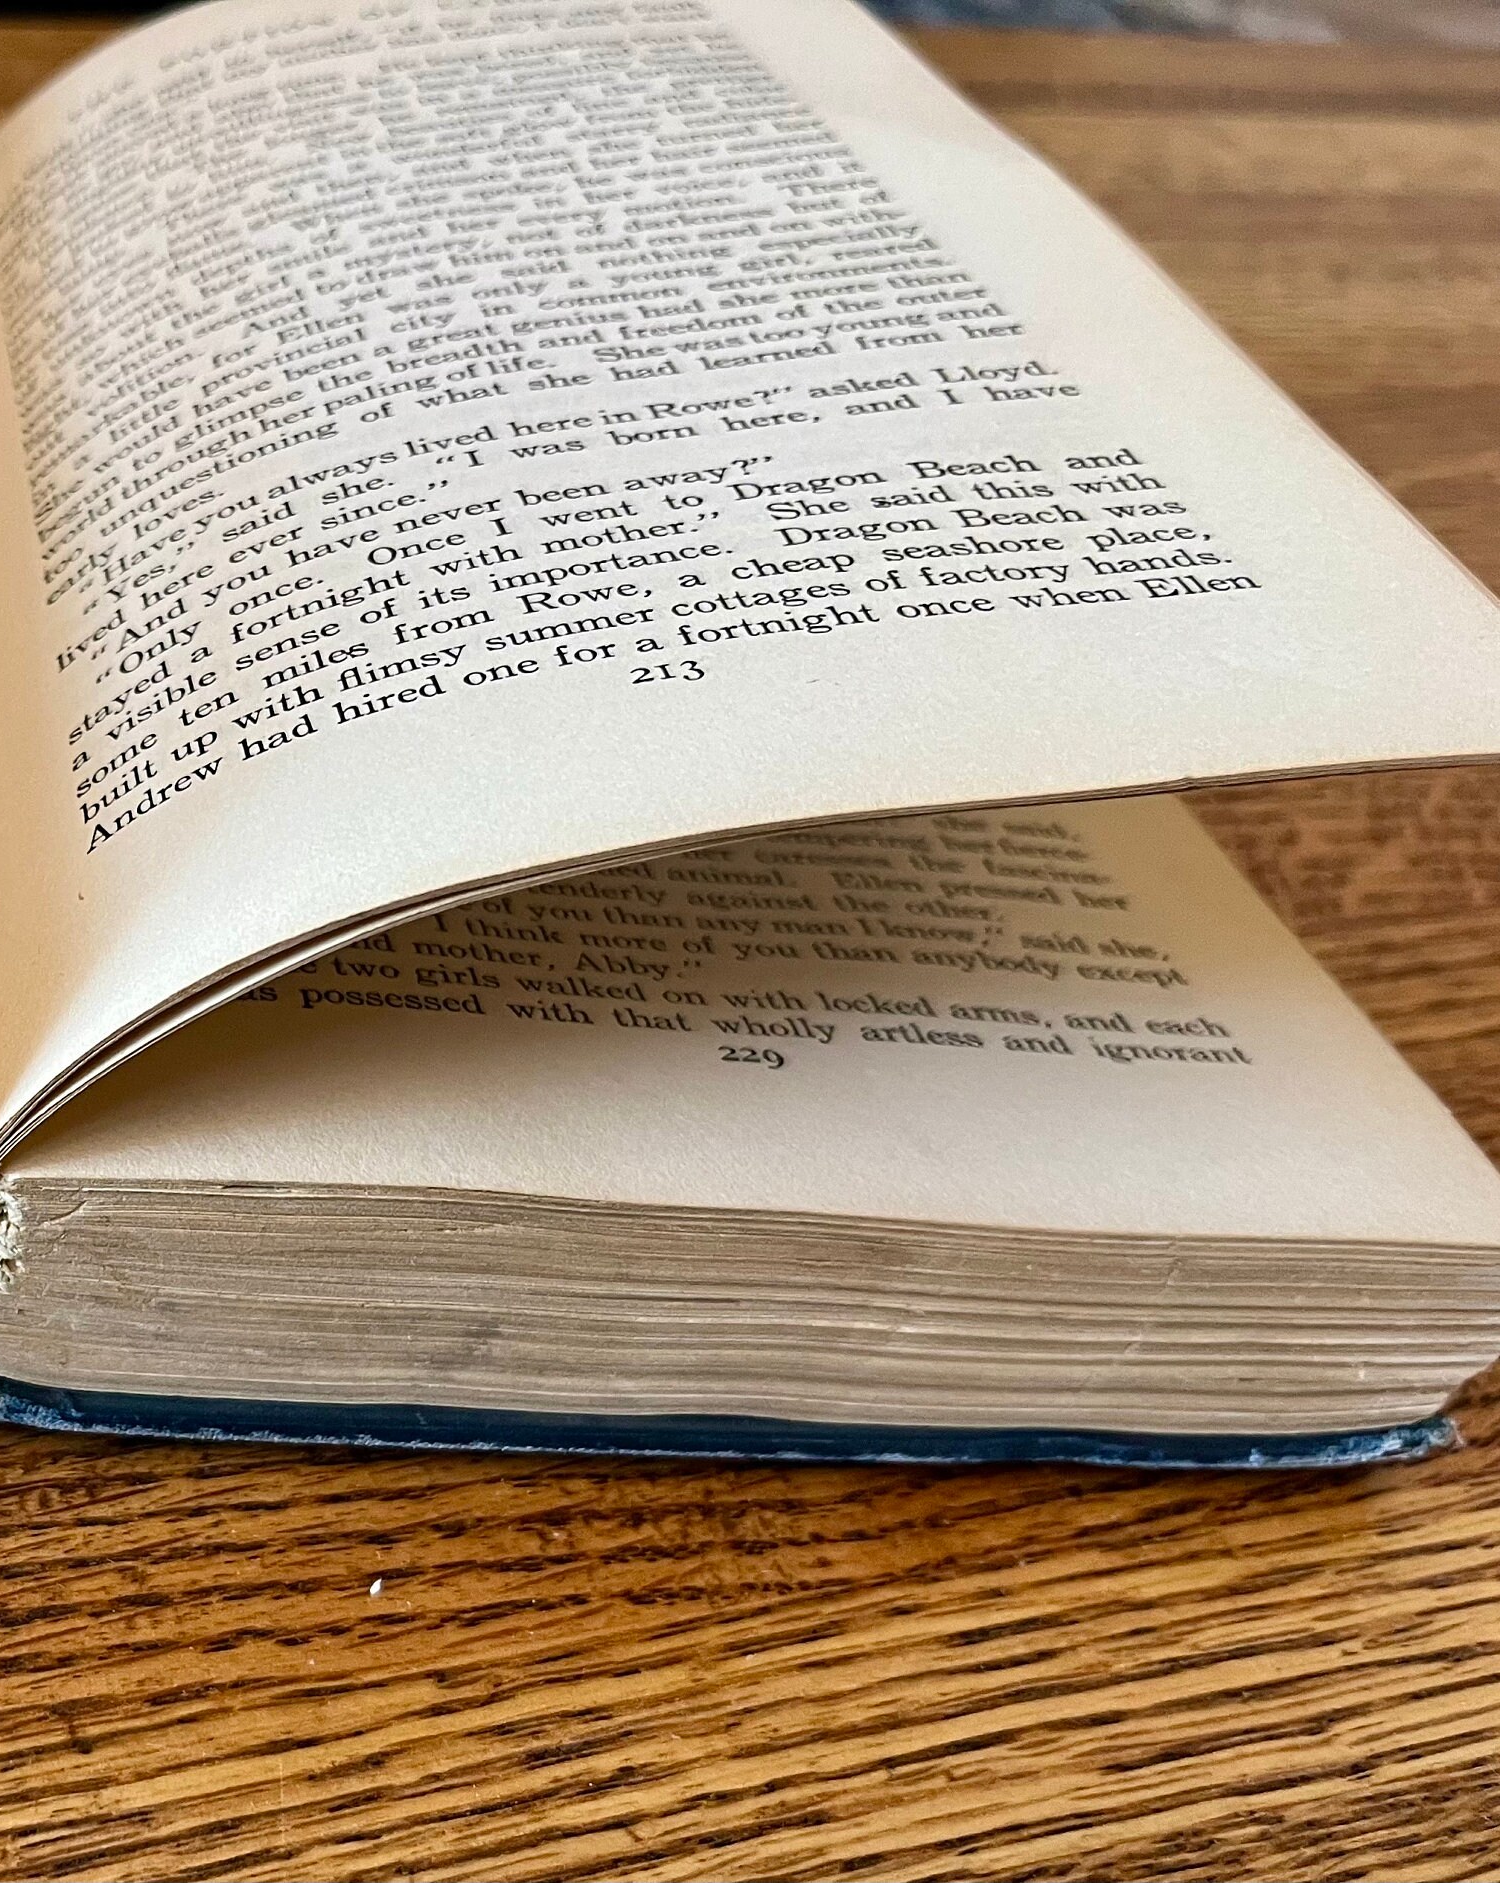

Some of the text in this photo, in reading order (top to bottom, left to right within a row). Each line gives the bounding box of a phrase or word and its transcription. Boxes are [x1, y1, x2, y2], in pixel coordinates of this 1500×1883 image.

[360, 402, 393, 424] of
[415, 382, 509, 410] what
[527, 373, 592, 392] she
[612, 360, 680, 383] had
[699, 344, 835, 372] learned
[855, 333, 943, 351] from
[961, 322, 1024, 340] her
[192, 494, 260, 534] you
[267, 446, 398, 501] always
[404, 425, 497, 460] lived
[507, 412, 592, 438] here
[599, 409, 637, 426] in
[807, 373, 919, 400] asked
[930, 359, 1058, 386] Lloyd.
[69, 661, 171, 746] stayed
[190, 646, 213, 665] a
[231, 571, 408, 644] fortnight
[429, 544, 523, 576] with
[767, 499, 850, 522] She
[870, 486, 955, 508] said
[971, 479, 1055, 501] this
[1069, 471, 1166, 494] with
[72, 500, 1186, 772] a visible sense of its importance. Dragon Beach was
[77, 525, 1211, 797] some ten miles from Rowe, a cheap seashore place,
[630, 660, 705, 685] 213
[79, 548, 1232, 824] built up with flimsy summer cottages of factory hands.
[85, 571, 1262, 854] Andrew had hired one for a fortnight once when Ellen
[233, 982, 1253, 1065] as possessed with that wholly artless and ignorant
[333, 957, 401, 980] two
[415, 963, 500, 989] girls
[515, 975, 646, 1004] walked
[662, 989, 706, 1006] on
[722, 991, 804, 1012] with
[817, 992, 936, 1018] locked
[948, 1001, 1052, 1028] arms,
[1063, 1011, 1132, 1035] and
[1145, 1014, 1231, 1037] each
[413, 938, 556, 971] mother,
[718, 1044, 785, 1068] 229
